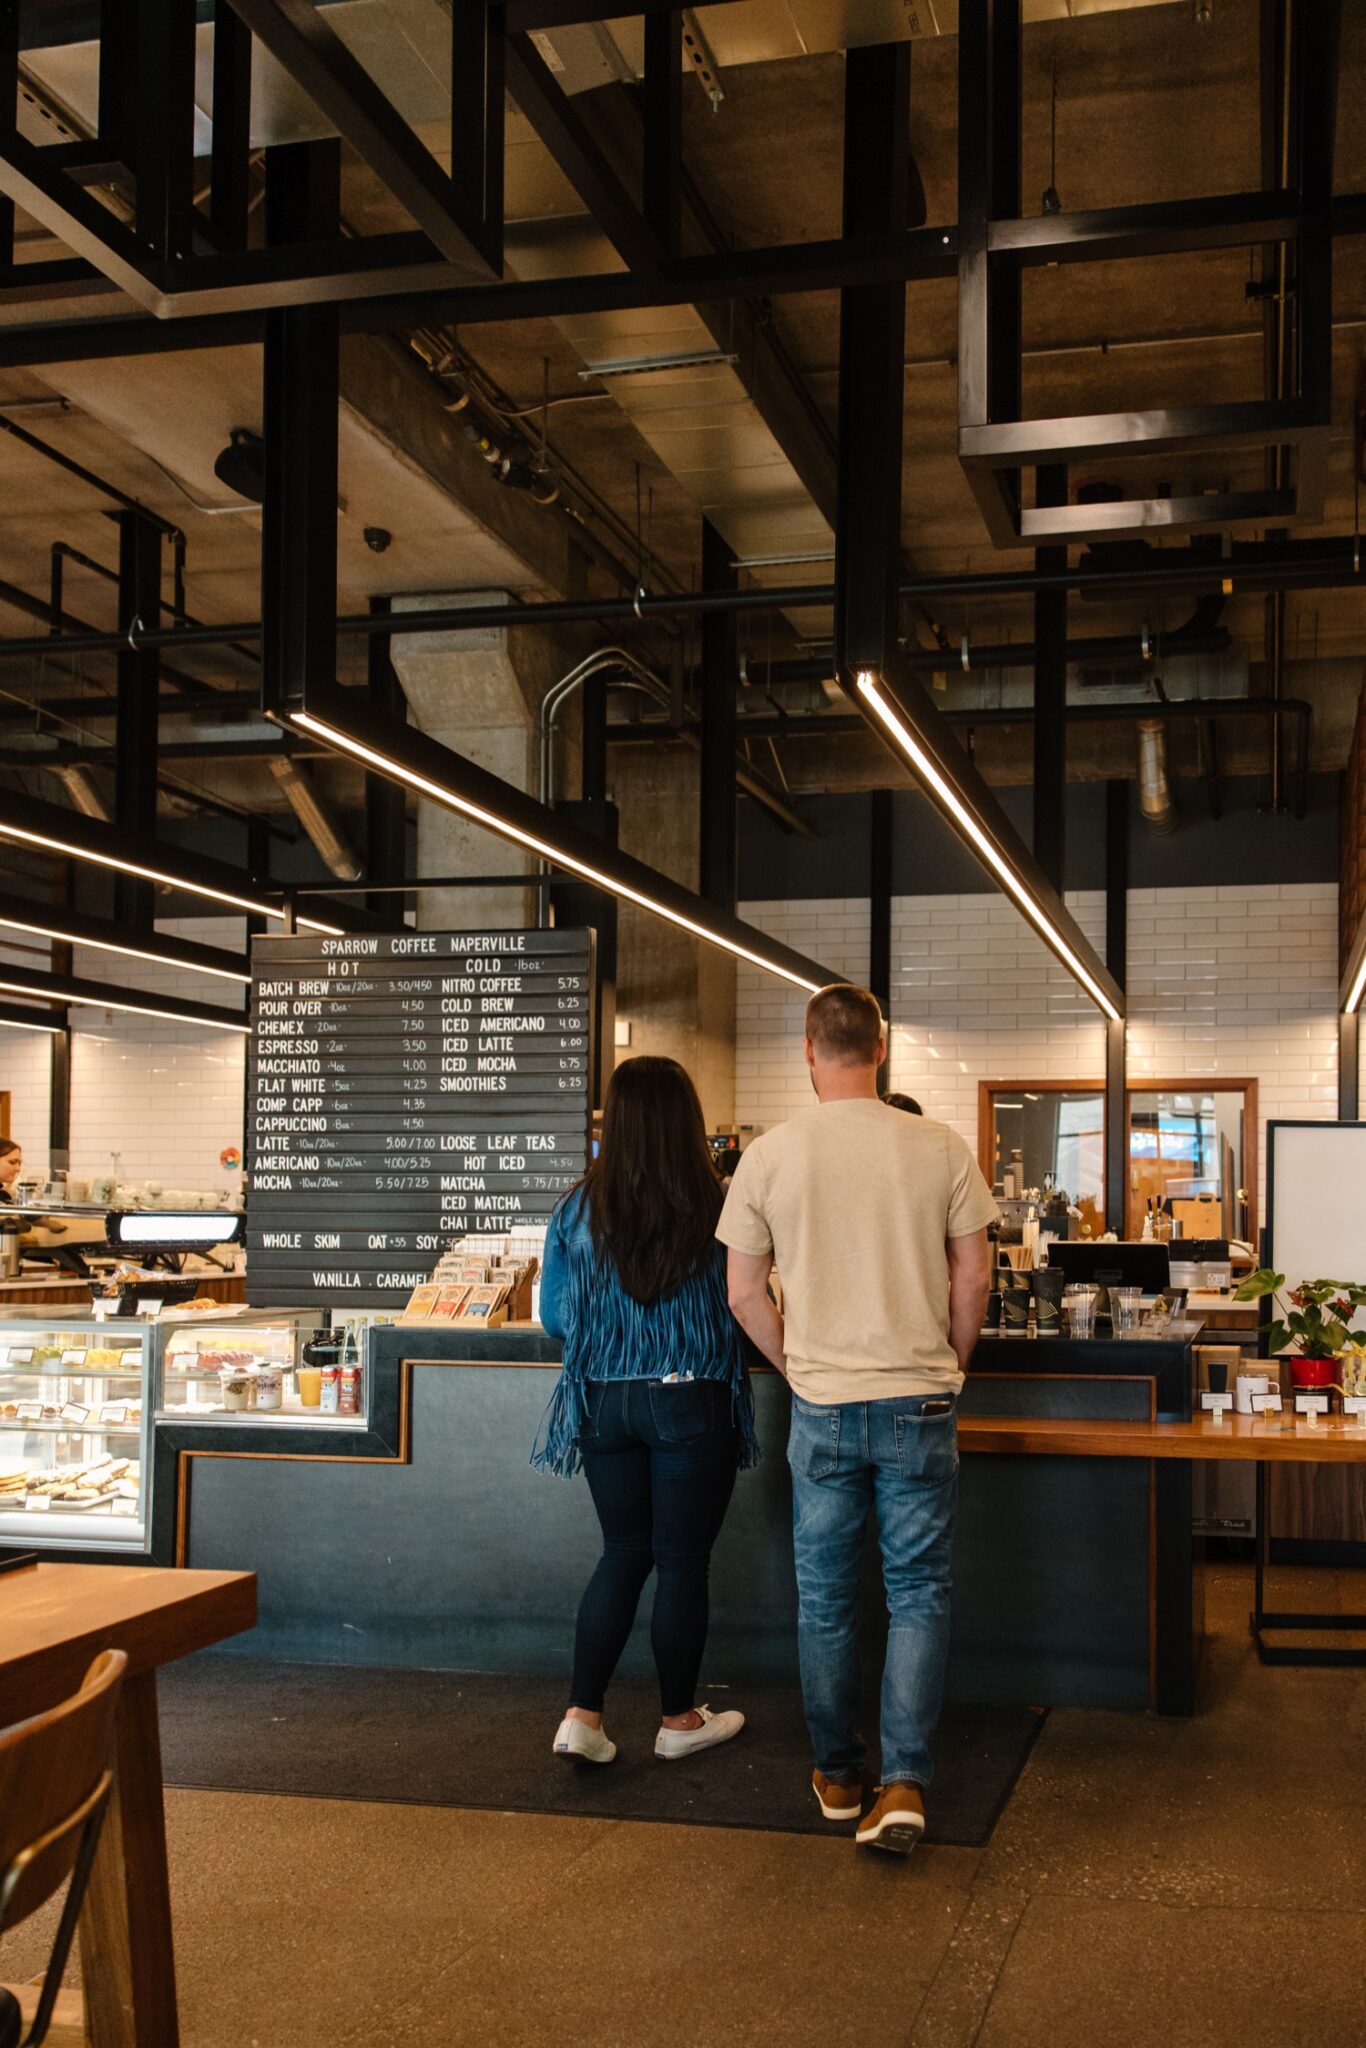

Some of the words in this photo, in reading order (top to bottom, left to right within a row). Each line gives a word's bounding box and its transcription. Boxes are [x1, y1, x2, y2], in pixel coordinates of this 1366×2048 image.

[321, 939, 378, 955] SPARROW
[391, 937, 437, 954] COFFEE
[450, 936, 526, 952] NAPERVILLE
[327, 962, 360, 976] HOT
[465, 958, 501, 973] COLD
[258, 982, 293, 996] BATCH
[299, 981, 330, 995] BREW
[441, 978, 475, 993] NITRO
[479, 977, 522, 992] COFFEE
[558, 977, 580, 990] 5.75
[258, 1001, 288, 1016] POUR
[293, 1001, 322, 1015] OVER
[401, 1000, 425, 1011] 4.50
[441, 999, 472, 1013] COLD
[481, 998, 514, 1012] BREW
[557, 997, 580, 1009] 6.25
[257, 1020, 304, 1035] CHEMEX
[402, 1019, 425, 1031] 7.50
[442, 1018, 469, 1033] ICED
[479, 1017, 545, 1032] AMERICANO
[559, 1018, 581, 1029] 4.00
[257, 1040, 319, 1055] ESPRESSO
[402, 1039, 427, 1051] 3.50
[442, 1038, 469, 1052] ICED
[478, 1037, 514, 1051] LATTE
[560, 1038, 582, 1048] 6.00
[257, 1059, 321, 1074] MACCHIATO
[402, 1059, 427, 1072] 4.00
[441, 1058, 467, 1072] ICED
[477, 1057, 517, 1071] MOCHA
[559, 1057, 580, 1069] 6.75
[257, 1079, 287, 1093] FLAT
[291, 1078, 326, 1093] WHITE
[403, 1079, 428, 1090] 4.25
[440, 1076, 507, 1092] SMOOTHIES
[558, 1077, 581, 1088] 6.25
[256, 1098, 287, 1113] COMP
[292, 1098, 323, 1112] CAPP
[402, 1098, 426, 1110] 4.35
[255, 1117, 327, 1132] CAPPUCCINO
[403, 1118, 424, 1130] 4.50
[256, 1136, 290, 1151] LATTE
[440, 1136, 477, 1150] LOOSE
[487, 1136, 518, 1150] LEAF
[525, 1135, 556, 1150] TEAS
[254, 1156, 319, 1171] AMERICANO
[463, 1156, 487, 1171] HOT
[499, 1156, 526, 1170] ICED
[253, 1175, 292, 1190] MOCHA
[440, 1176, 486, 1191] MATCHA
[441, 1196, 467, 1210] ICED
[474, 1196, 522, 1211] MATCHA
[440, 1216, 468, 1230] CHAI
[476, 1216, 513, 1230] LATTE
[263, 1233, 302, 1248] WHOLE
[314, 1234, 341, 1249] SKIM
[368, 1234, 388, 1249] OAT
[416, 1235, 439, 1249] SOY
[313, 1272, 361, 1287] VANILLA
[376, 1273, 429, 1288] CARAMEL
